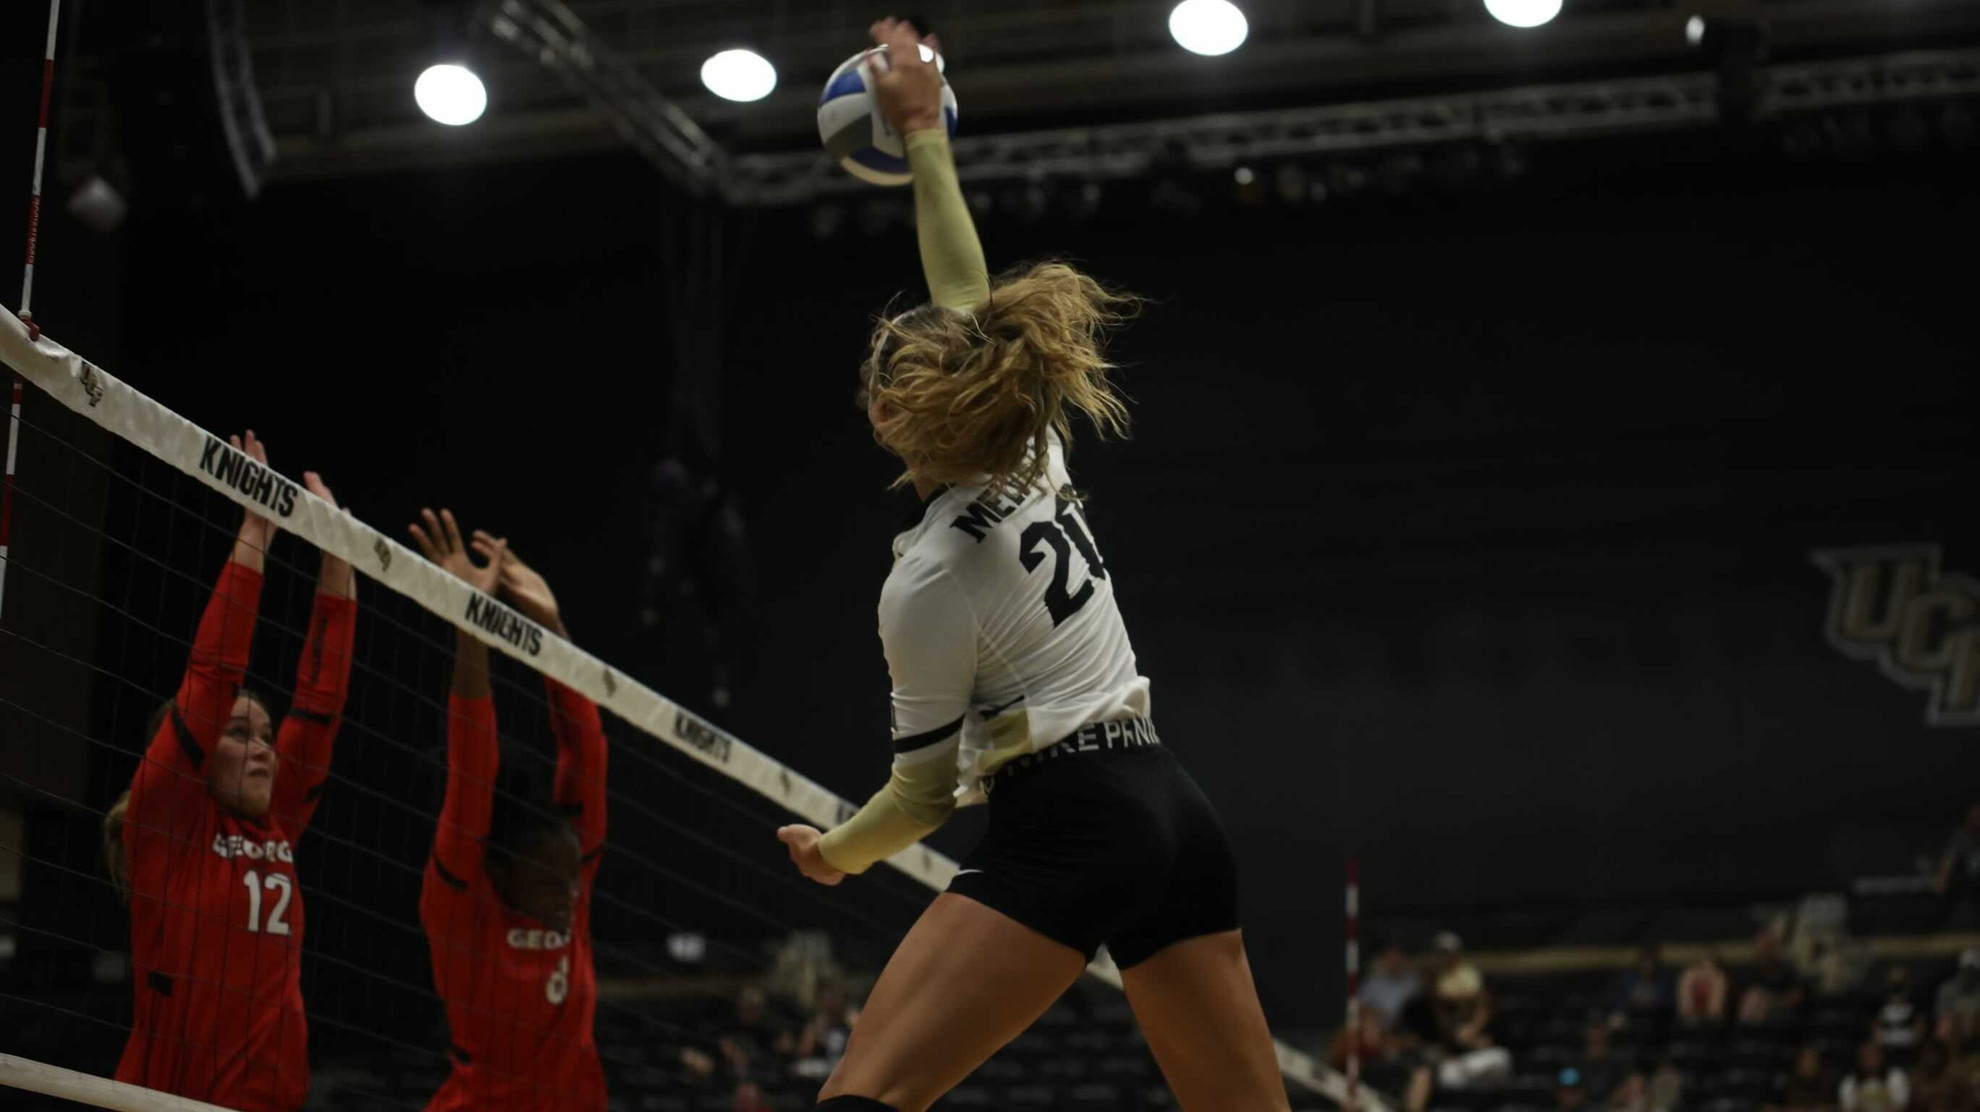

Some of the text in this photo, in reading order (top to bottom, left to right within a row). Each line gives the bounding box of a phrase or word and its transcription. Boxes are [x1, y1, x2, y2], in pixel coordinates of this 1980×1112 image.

[200, 433, 298, 518] KNIGHTS
[464, 593, 543, 657] KNIGHTS
[243, 869, 293, 937] 12
